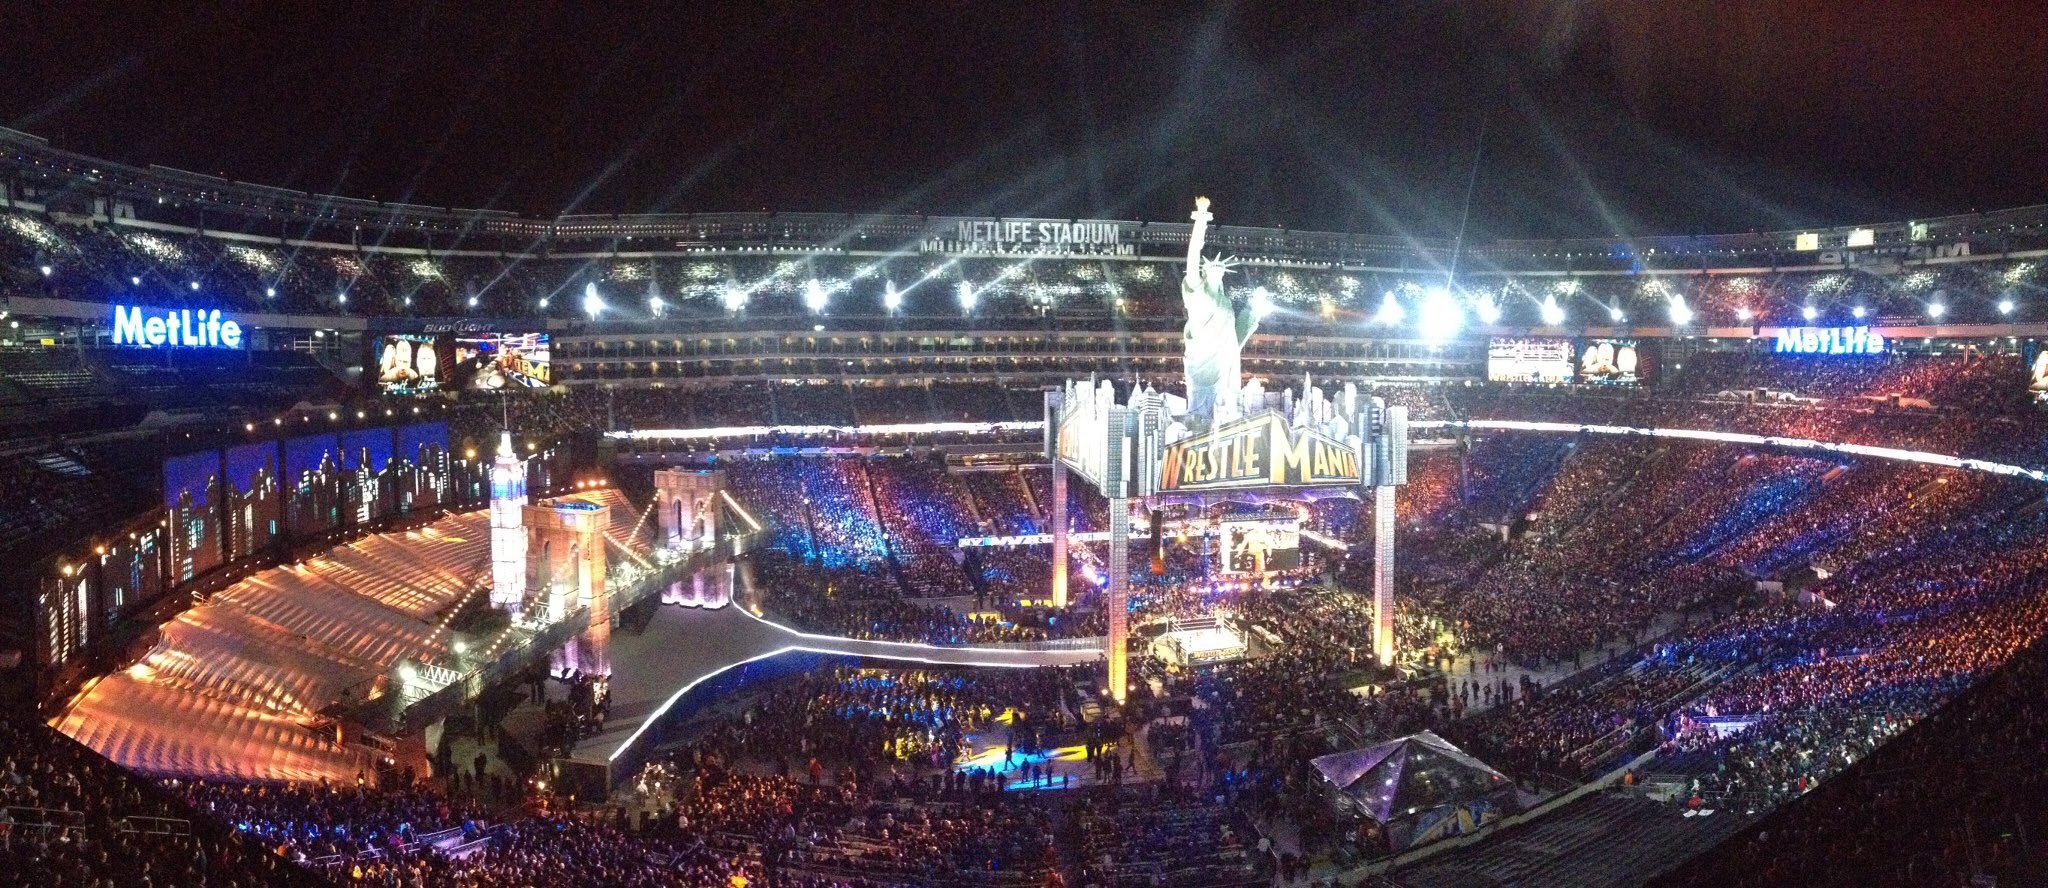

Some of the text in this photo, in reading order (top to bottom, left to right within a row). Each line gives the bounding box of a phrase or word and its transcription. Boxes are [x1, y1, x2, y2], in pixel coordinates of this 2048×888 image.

[958, 220, 1120, 245] METLIFE STADIUM
[113, 304, 242, 347] MetLife
[1776, 326, 1885, 354] MetLife
